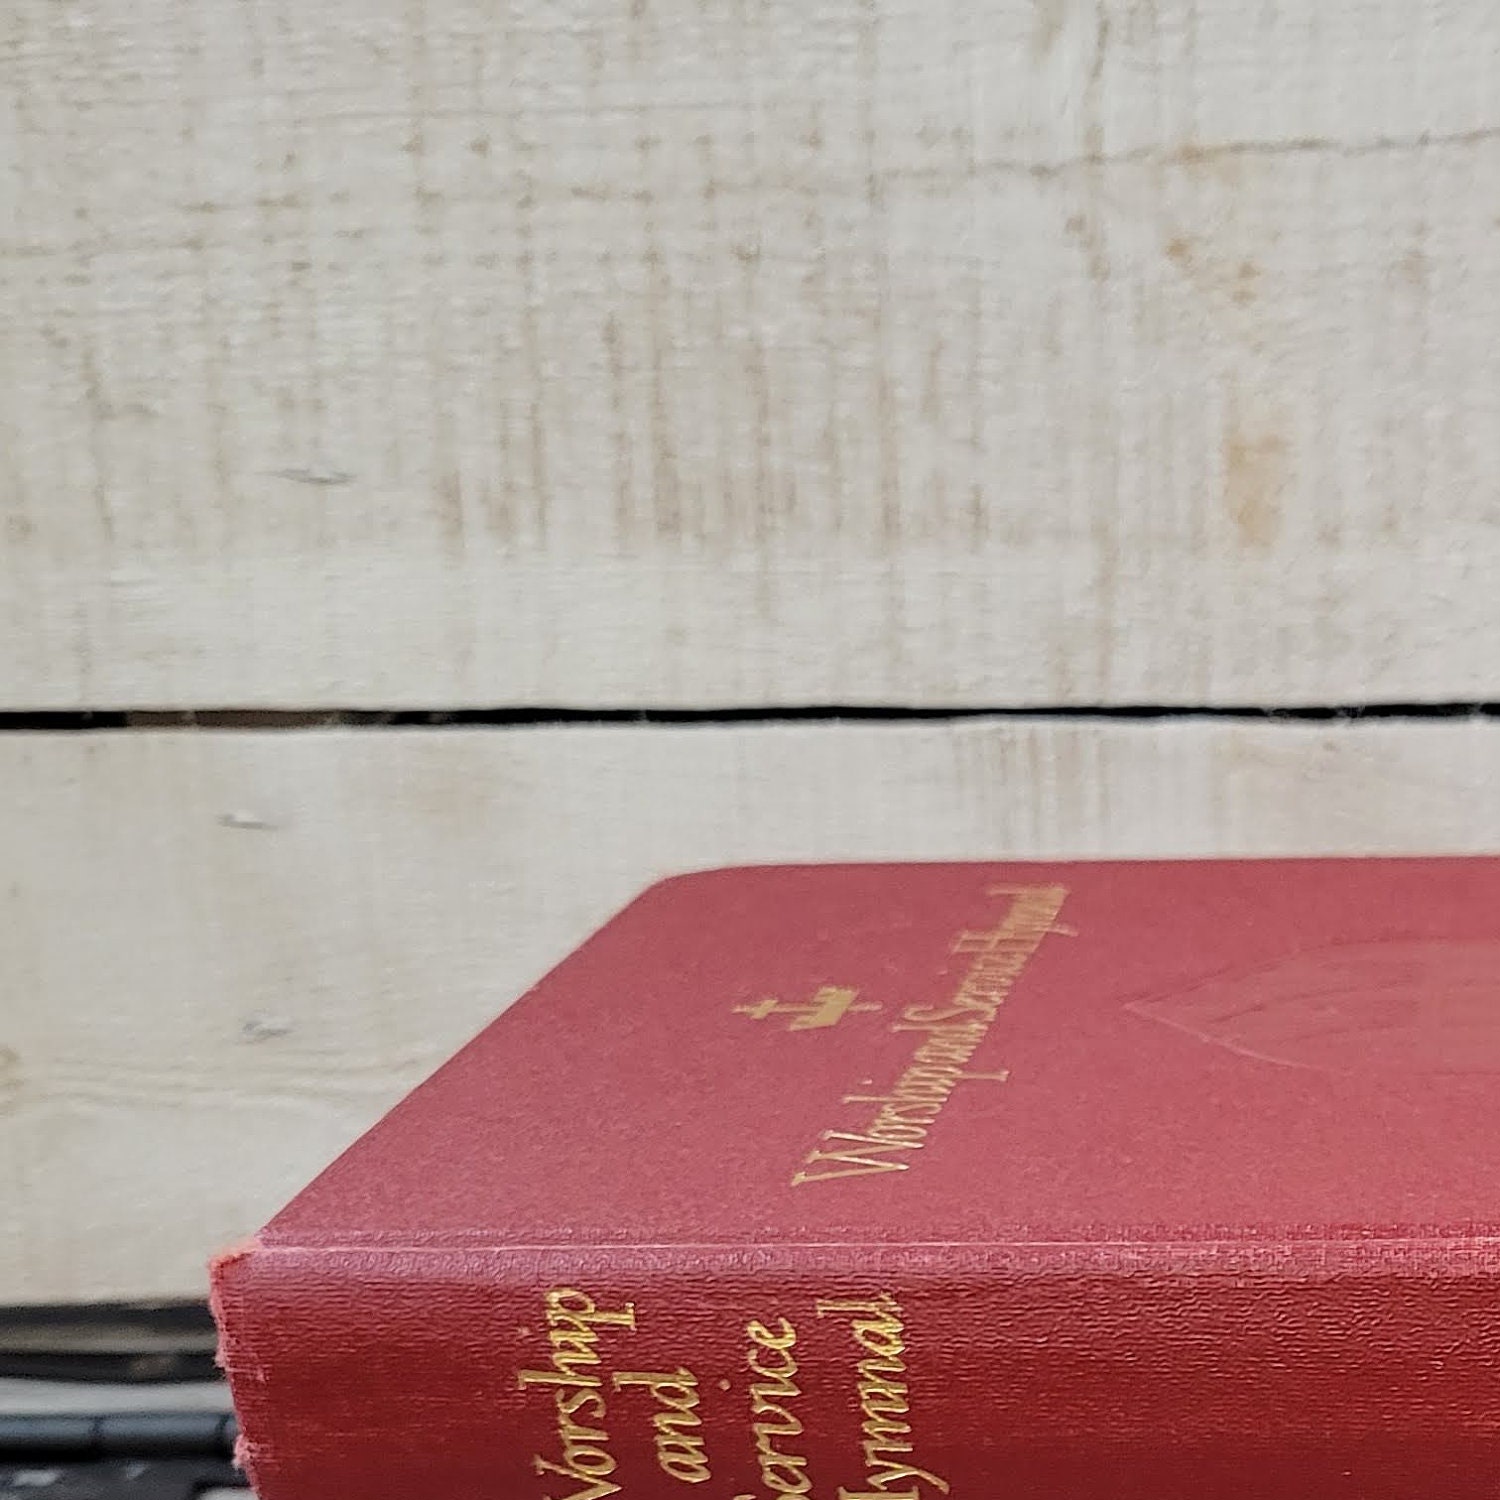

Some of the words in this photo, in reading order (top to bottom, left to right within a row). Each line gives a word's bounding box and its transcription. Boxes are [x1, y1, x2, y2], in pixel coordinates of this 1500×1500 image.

[892, 1022, 988, 1064] and
[791, 1065, 1010, 1187] Worship
[612, 1367, 711, 1483] and
